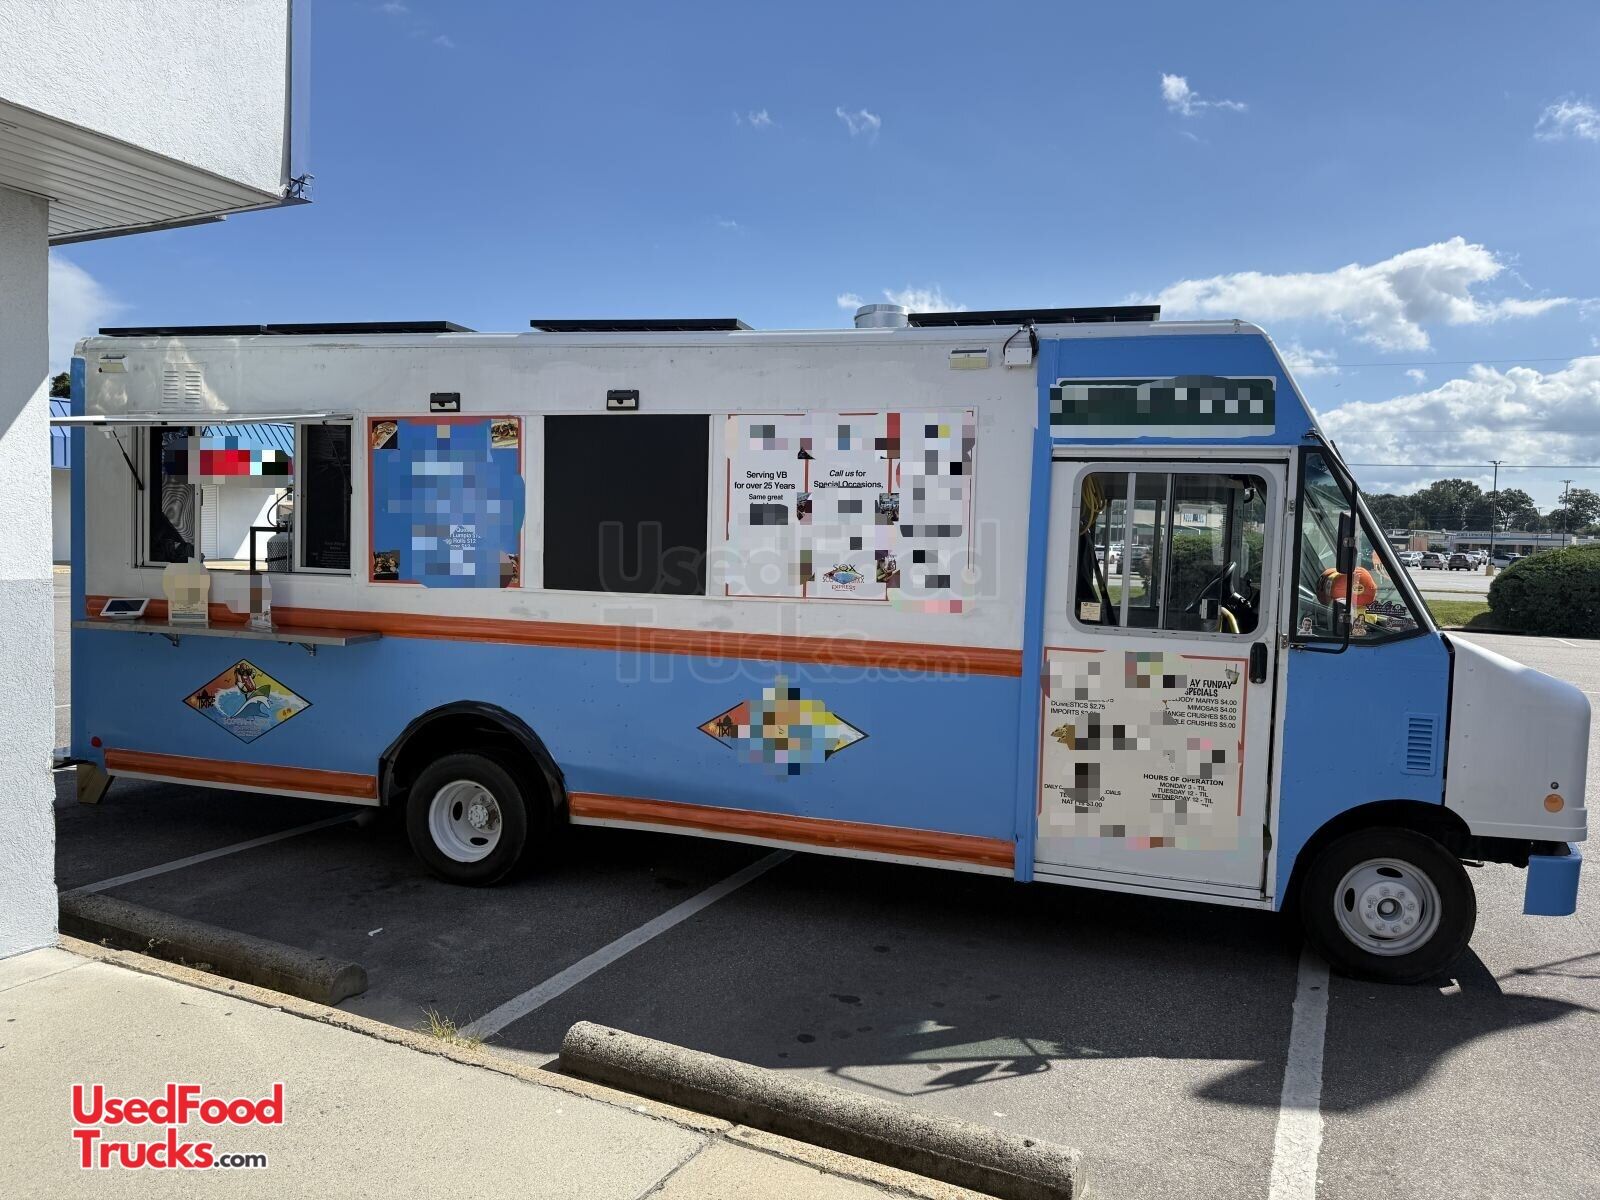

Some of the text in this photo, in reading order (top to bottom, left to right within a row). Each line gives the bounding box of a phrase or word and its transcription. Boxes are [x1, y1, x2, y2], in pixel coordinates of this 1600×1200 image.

[746, 470, 774, 480] Serving
[842, 480, 884, 489] Occasions,
[1203, 680, 1233, 689] FUNDAY
[1184, 688, 1218, 697] SPECIALS
[1187, 712, 1218, 720] CRUSHES
[1182, 777, 1224, 786] OPERATION
